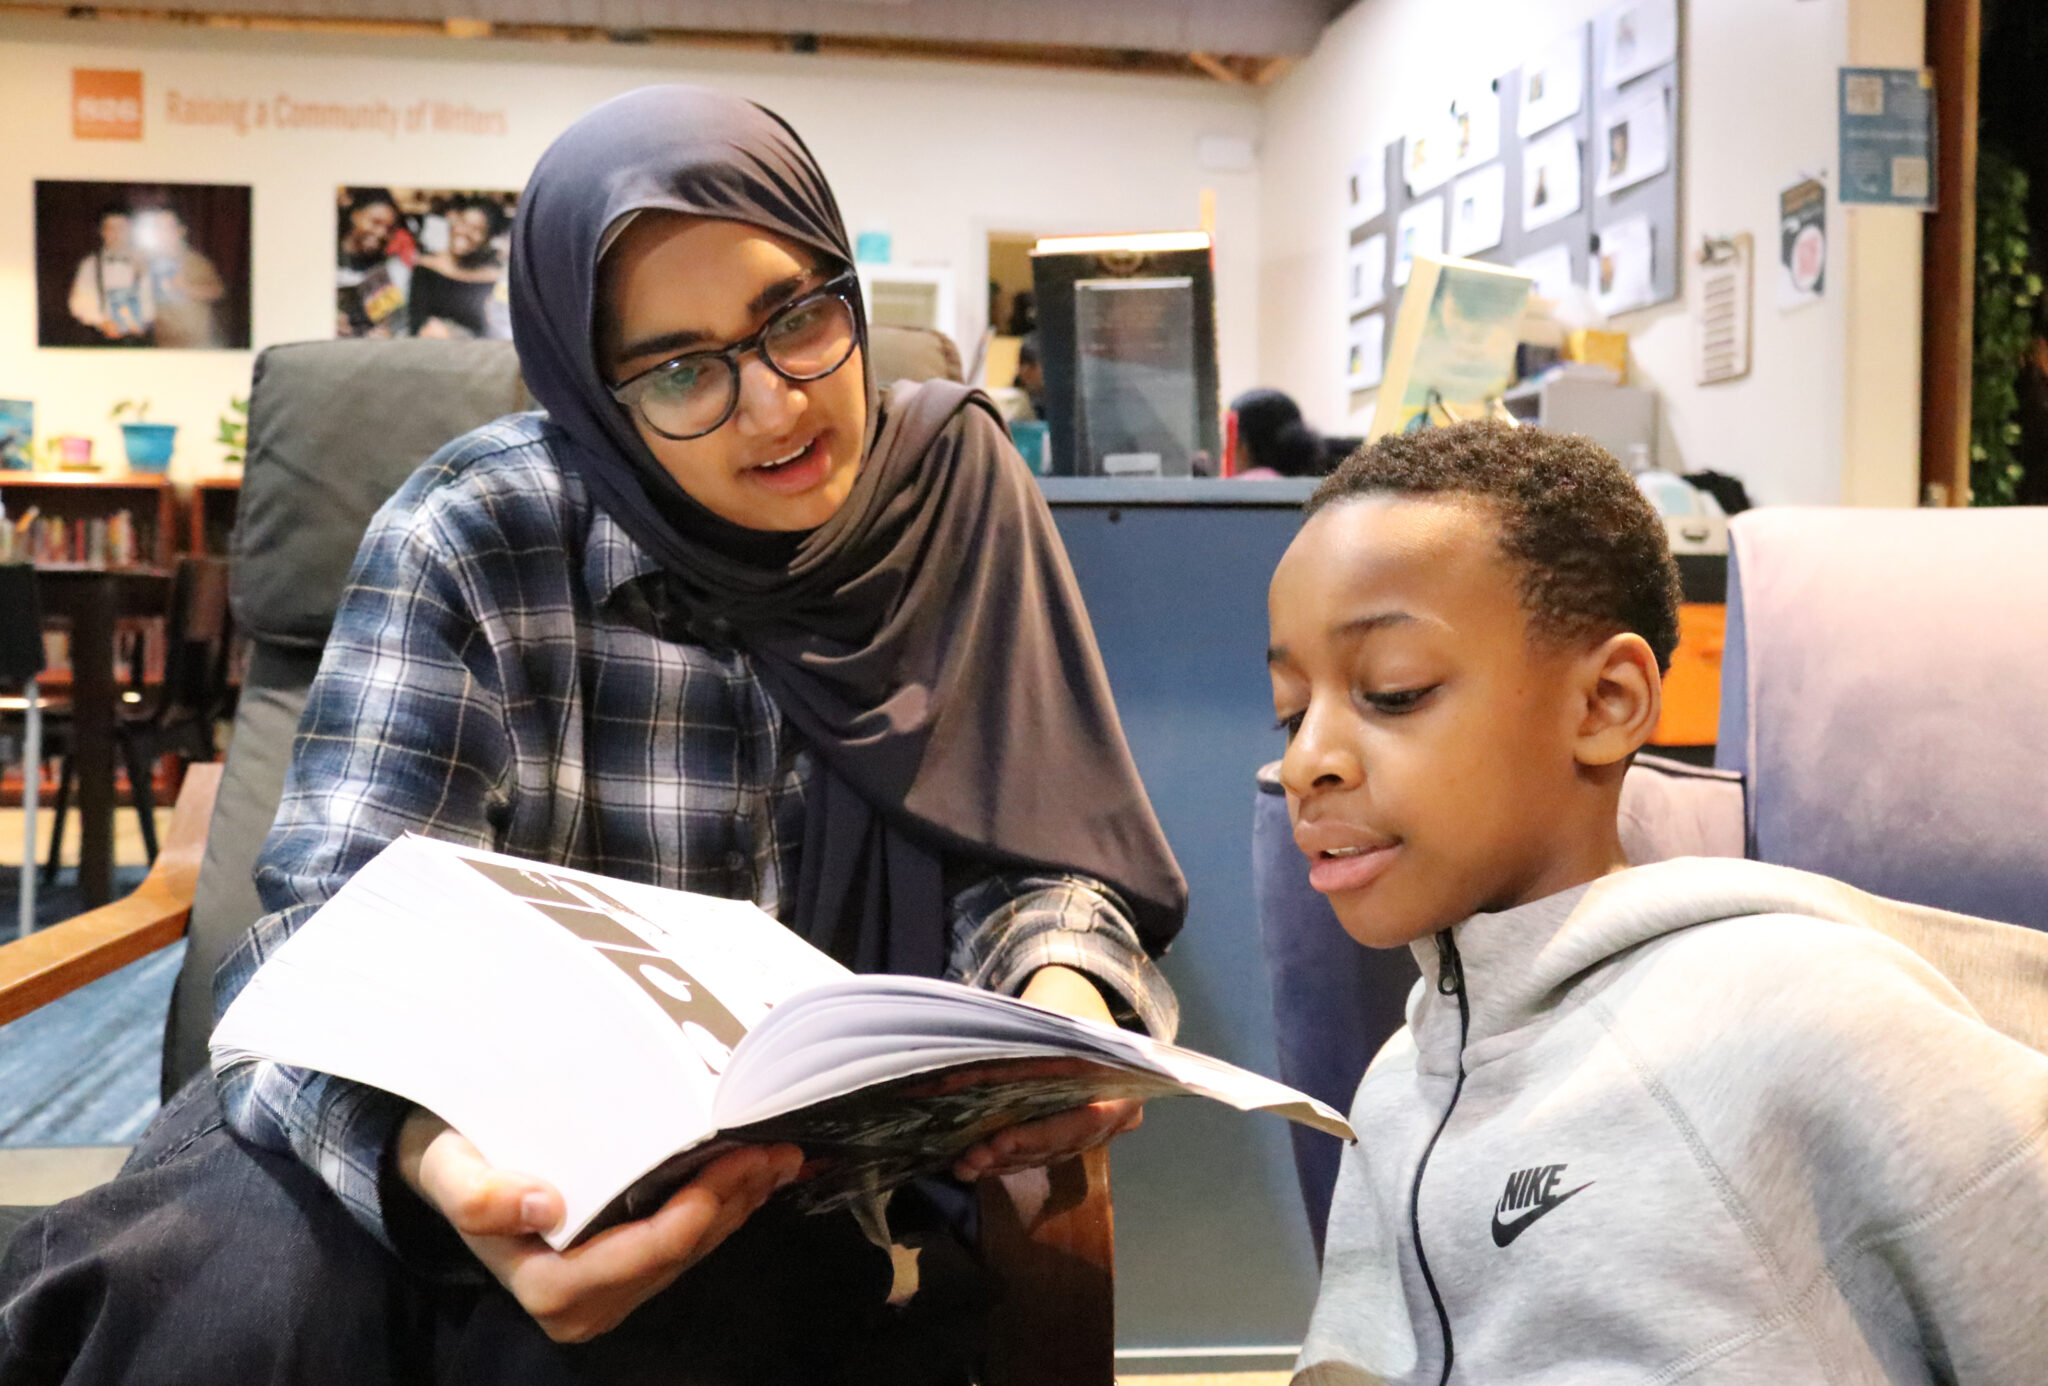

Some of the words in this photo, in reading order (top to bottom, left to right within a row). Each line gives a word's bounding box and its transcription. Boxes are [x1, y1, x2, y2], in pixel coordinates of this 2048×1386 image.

[165, 89, 248, 135] Raising
[257, 102, 267, 128] a
[275, 91, 397, 138] Community
[404, 99, 427, 133] of
[431, 99, 508, 136] Writers
[1500, 1164, 1568, 1212] NIKE
